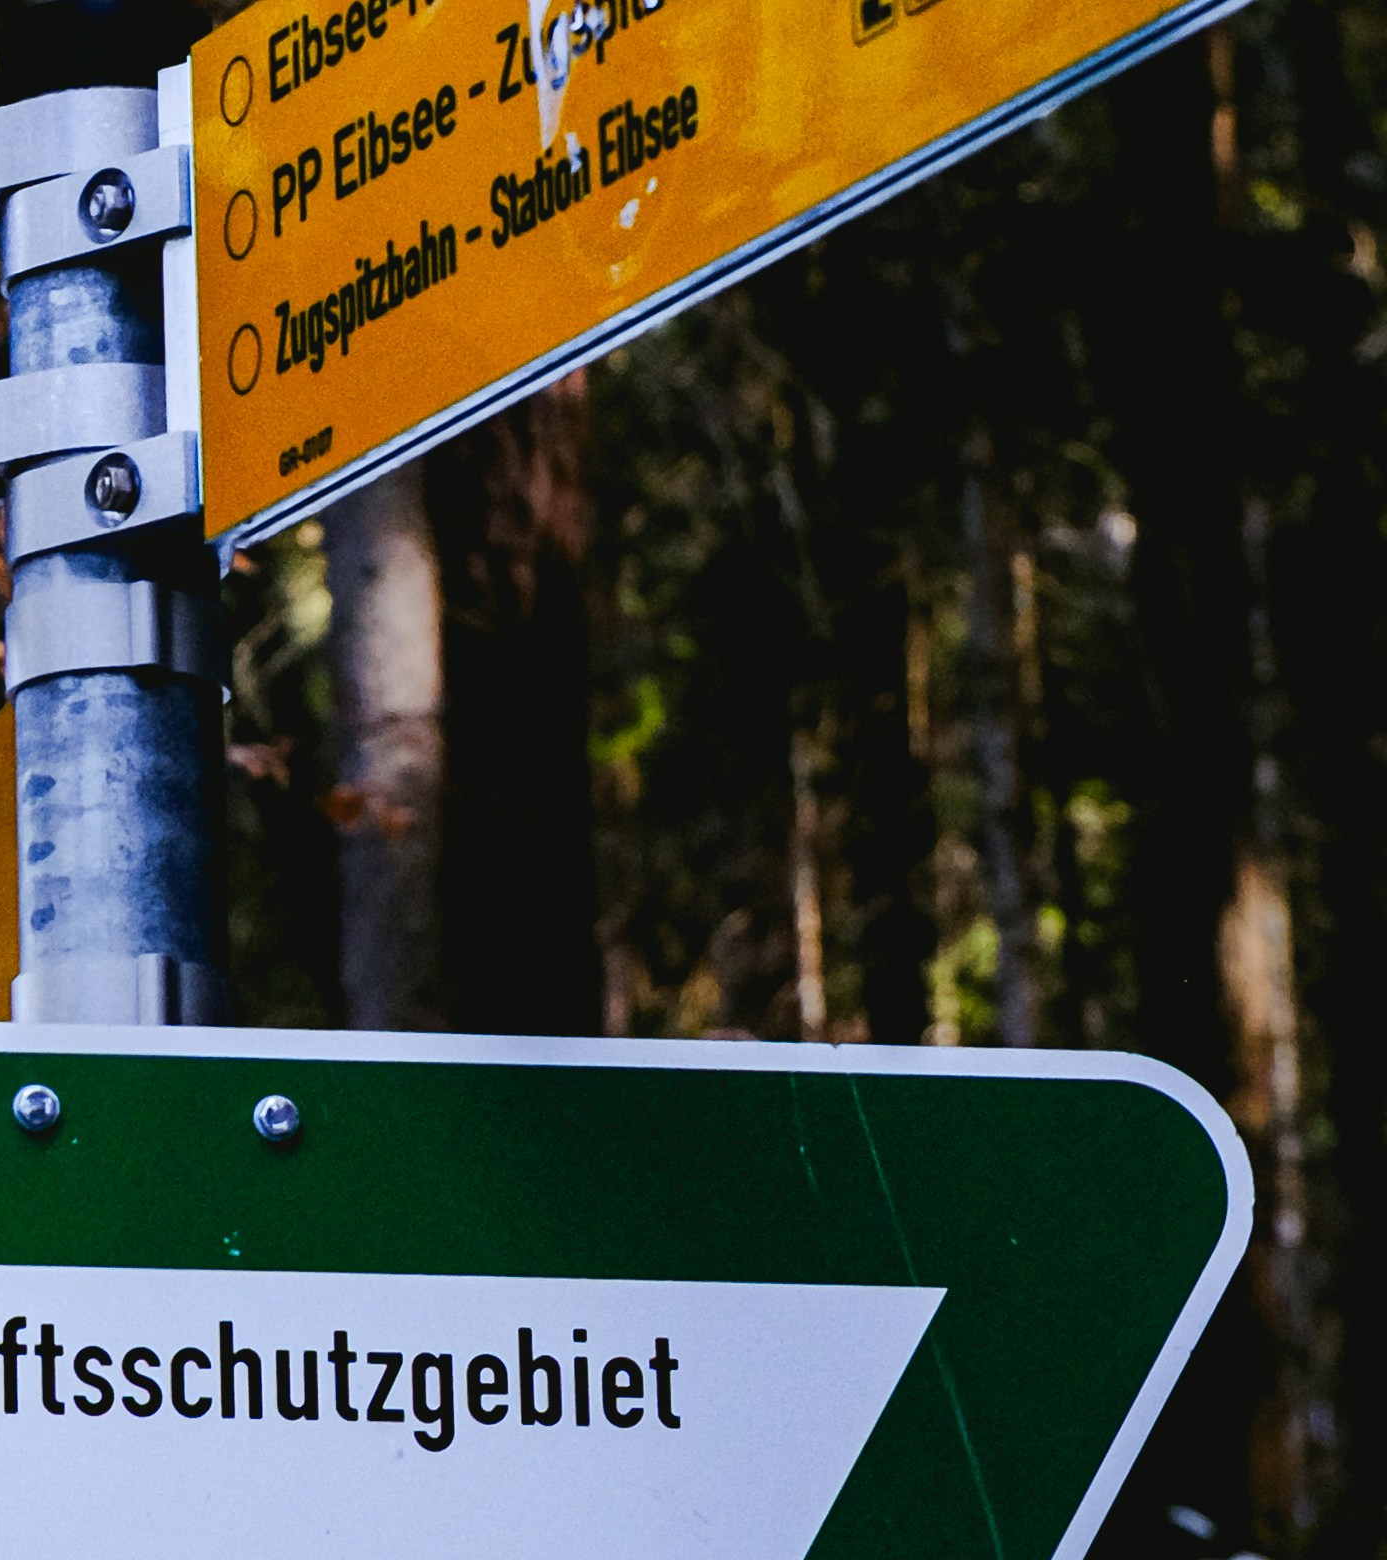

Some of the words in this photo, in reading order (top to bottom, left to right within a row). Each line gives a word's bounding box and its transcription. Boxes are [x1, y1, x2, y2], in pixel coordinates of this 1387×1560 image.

[273, 146, 323, 238] PP
[333, 84, 457, 201] Eibsee
[275, 219, 458, 374] Zugspitzbahn
[491, 144, 592, 249] Station
[598, 84, 699, 188] Eibsee
